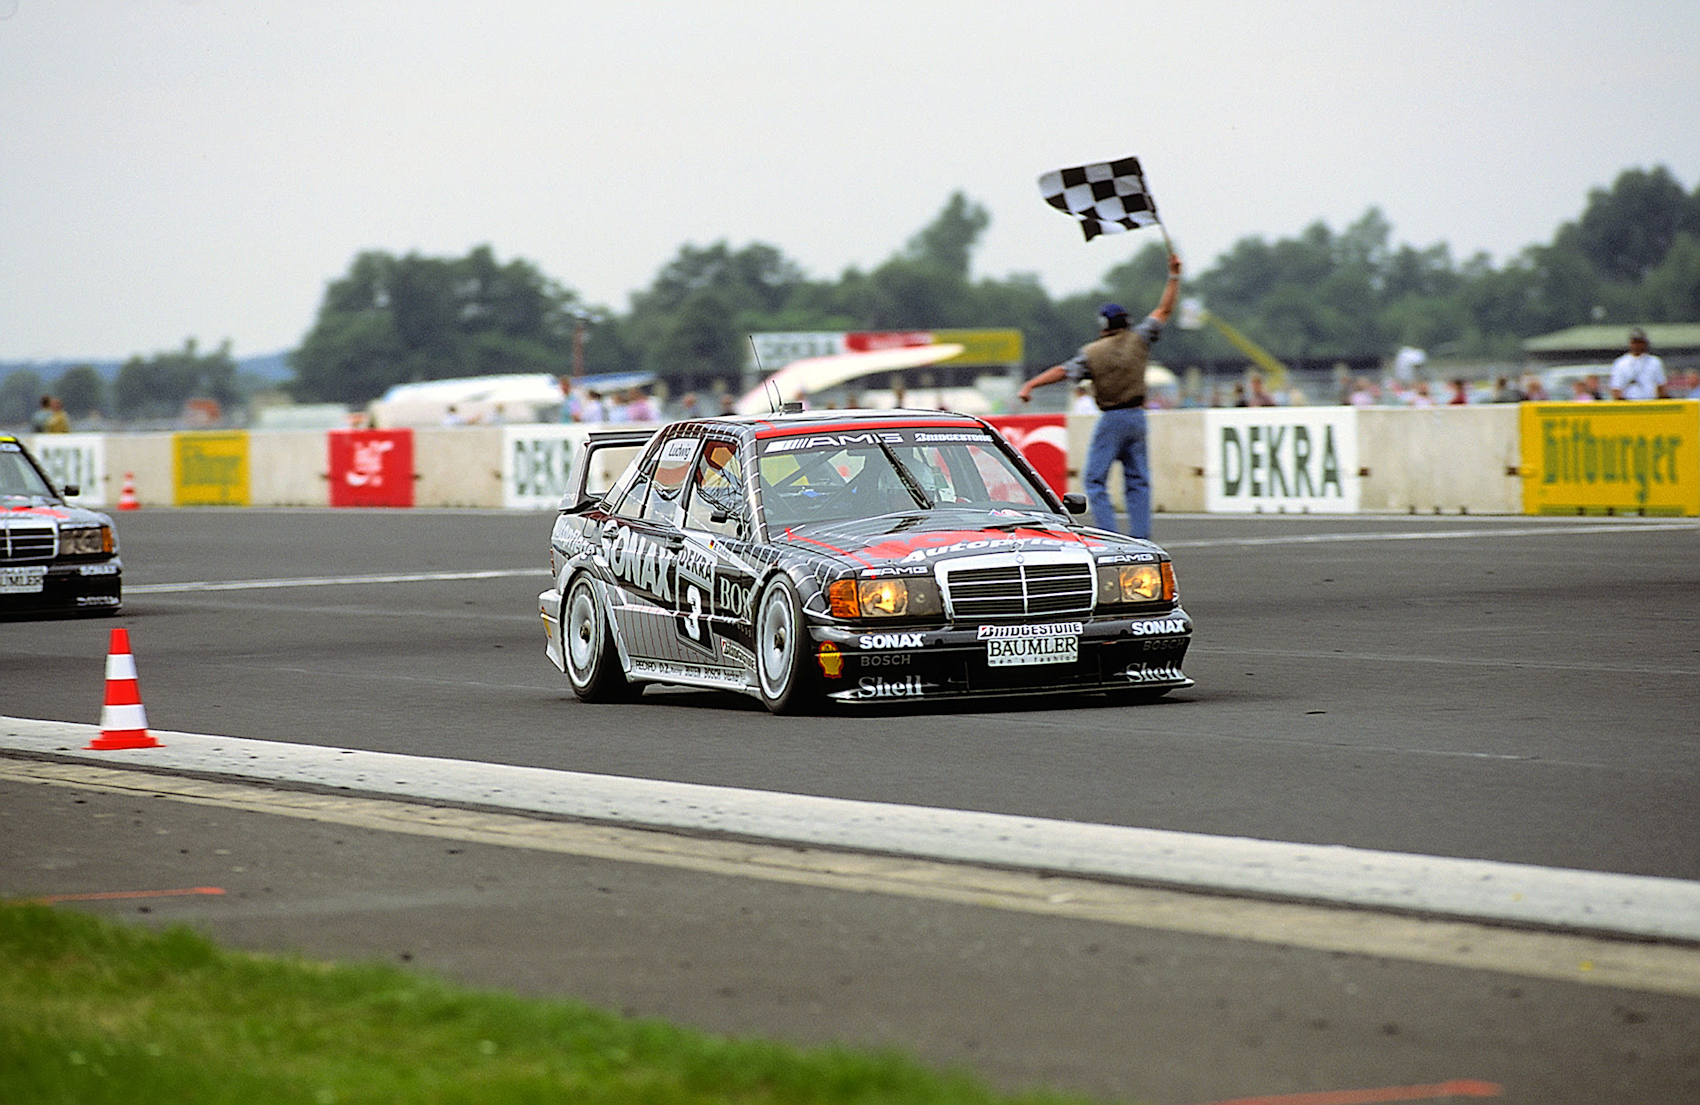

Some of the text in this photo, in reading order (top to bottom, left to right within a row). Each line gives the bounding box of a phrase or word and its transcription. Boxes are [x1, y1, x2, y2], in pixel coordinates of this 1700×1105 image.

[807, 433, 904, 449] AMG
[914, 433, 994, 442] BRIDGESTONE
[669, 443, 691, 460] Ludwig
[1221, 425, 1342, 497] DEKRA
[602, 519, 673, 603] SONAX
[1113, 553, 1154, 562] AMG
[679, 549, 712, 583] DEKRA
[879, 566, 928, 576] AMG
[684, 585, 702, 641] 3
[980, 622, 1082, 638] BRIDGESTONE
[1131, 619, 1187, 635] SONAX
[859, 634, 924, 649] SONAX
[1142, 638, 1186, 650] BOSCH
[861, 655, 911, 666] BOSCH
[1126, 660, 1187, 682] Shell
[858, 675, 924, 698] Shell
